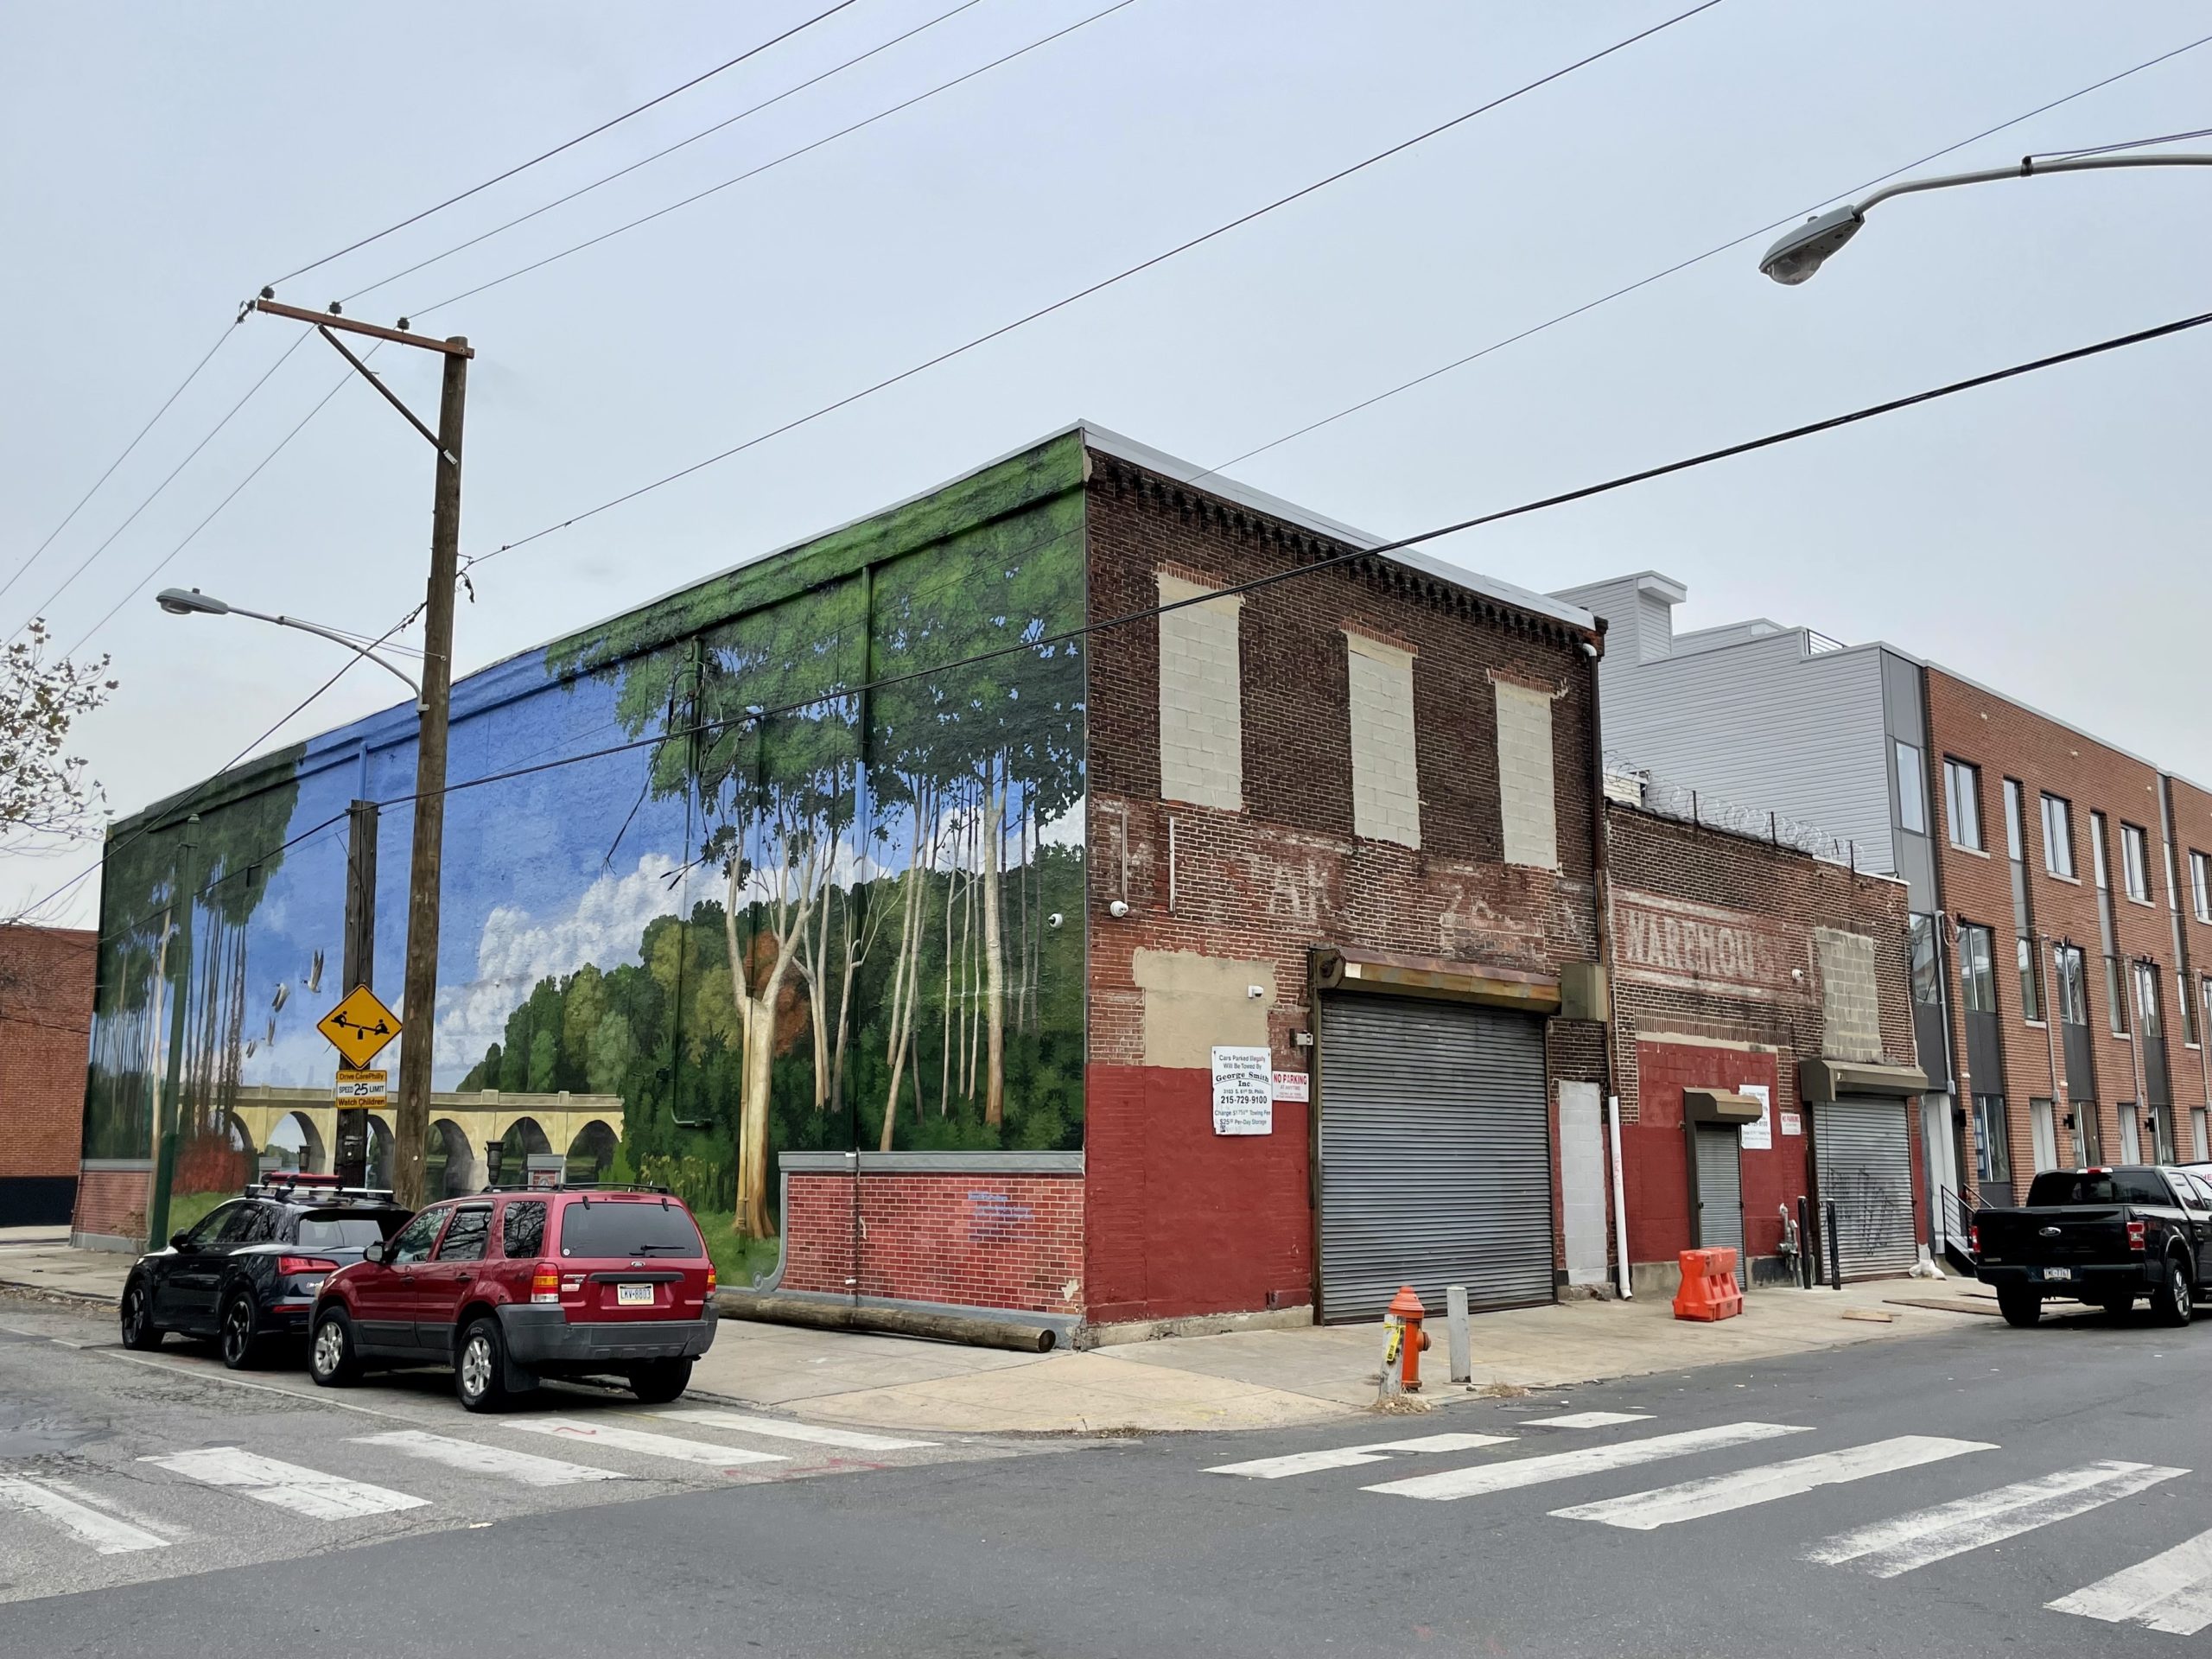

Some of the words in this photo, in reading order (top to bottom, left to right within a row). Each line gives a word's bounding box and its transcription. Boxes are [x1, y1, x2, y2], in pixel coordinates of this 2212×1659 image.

[1216, 1073, 1245, 1082] George
[1249, 1071, 1269, 1082] Smith
[1274, 1073, 1281, 1084] NO
[1283, 1075, 1306, 1085] PARKING
[354, 1084, 368, 1096] 25
[1221, 1096, 1268, 1104] 215-729-9100
